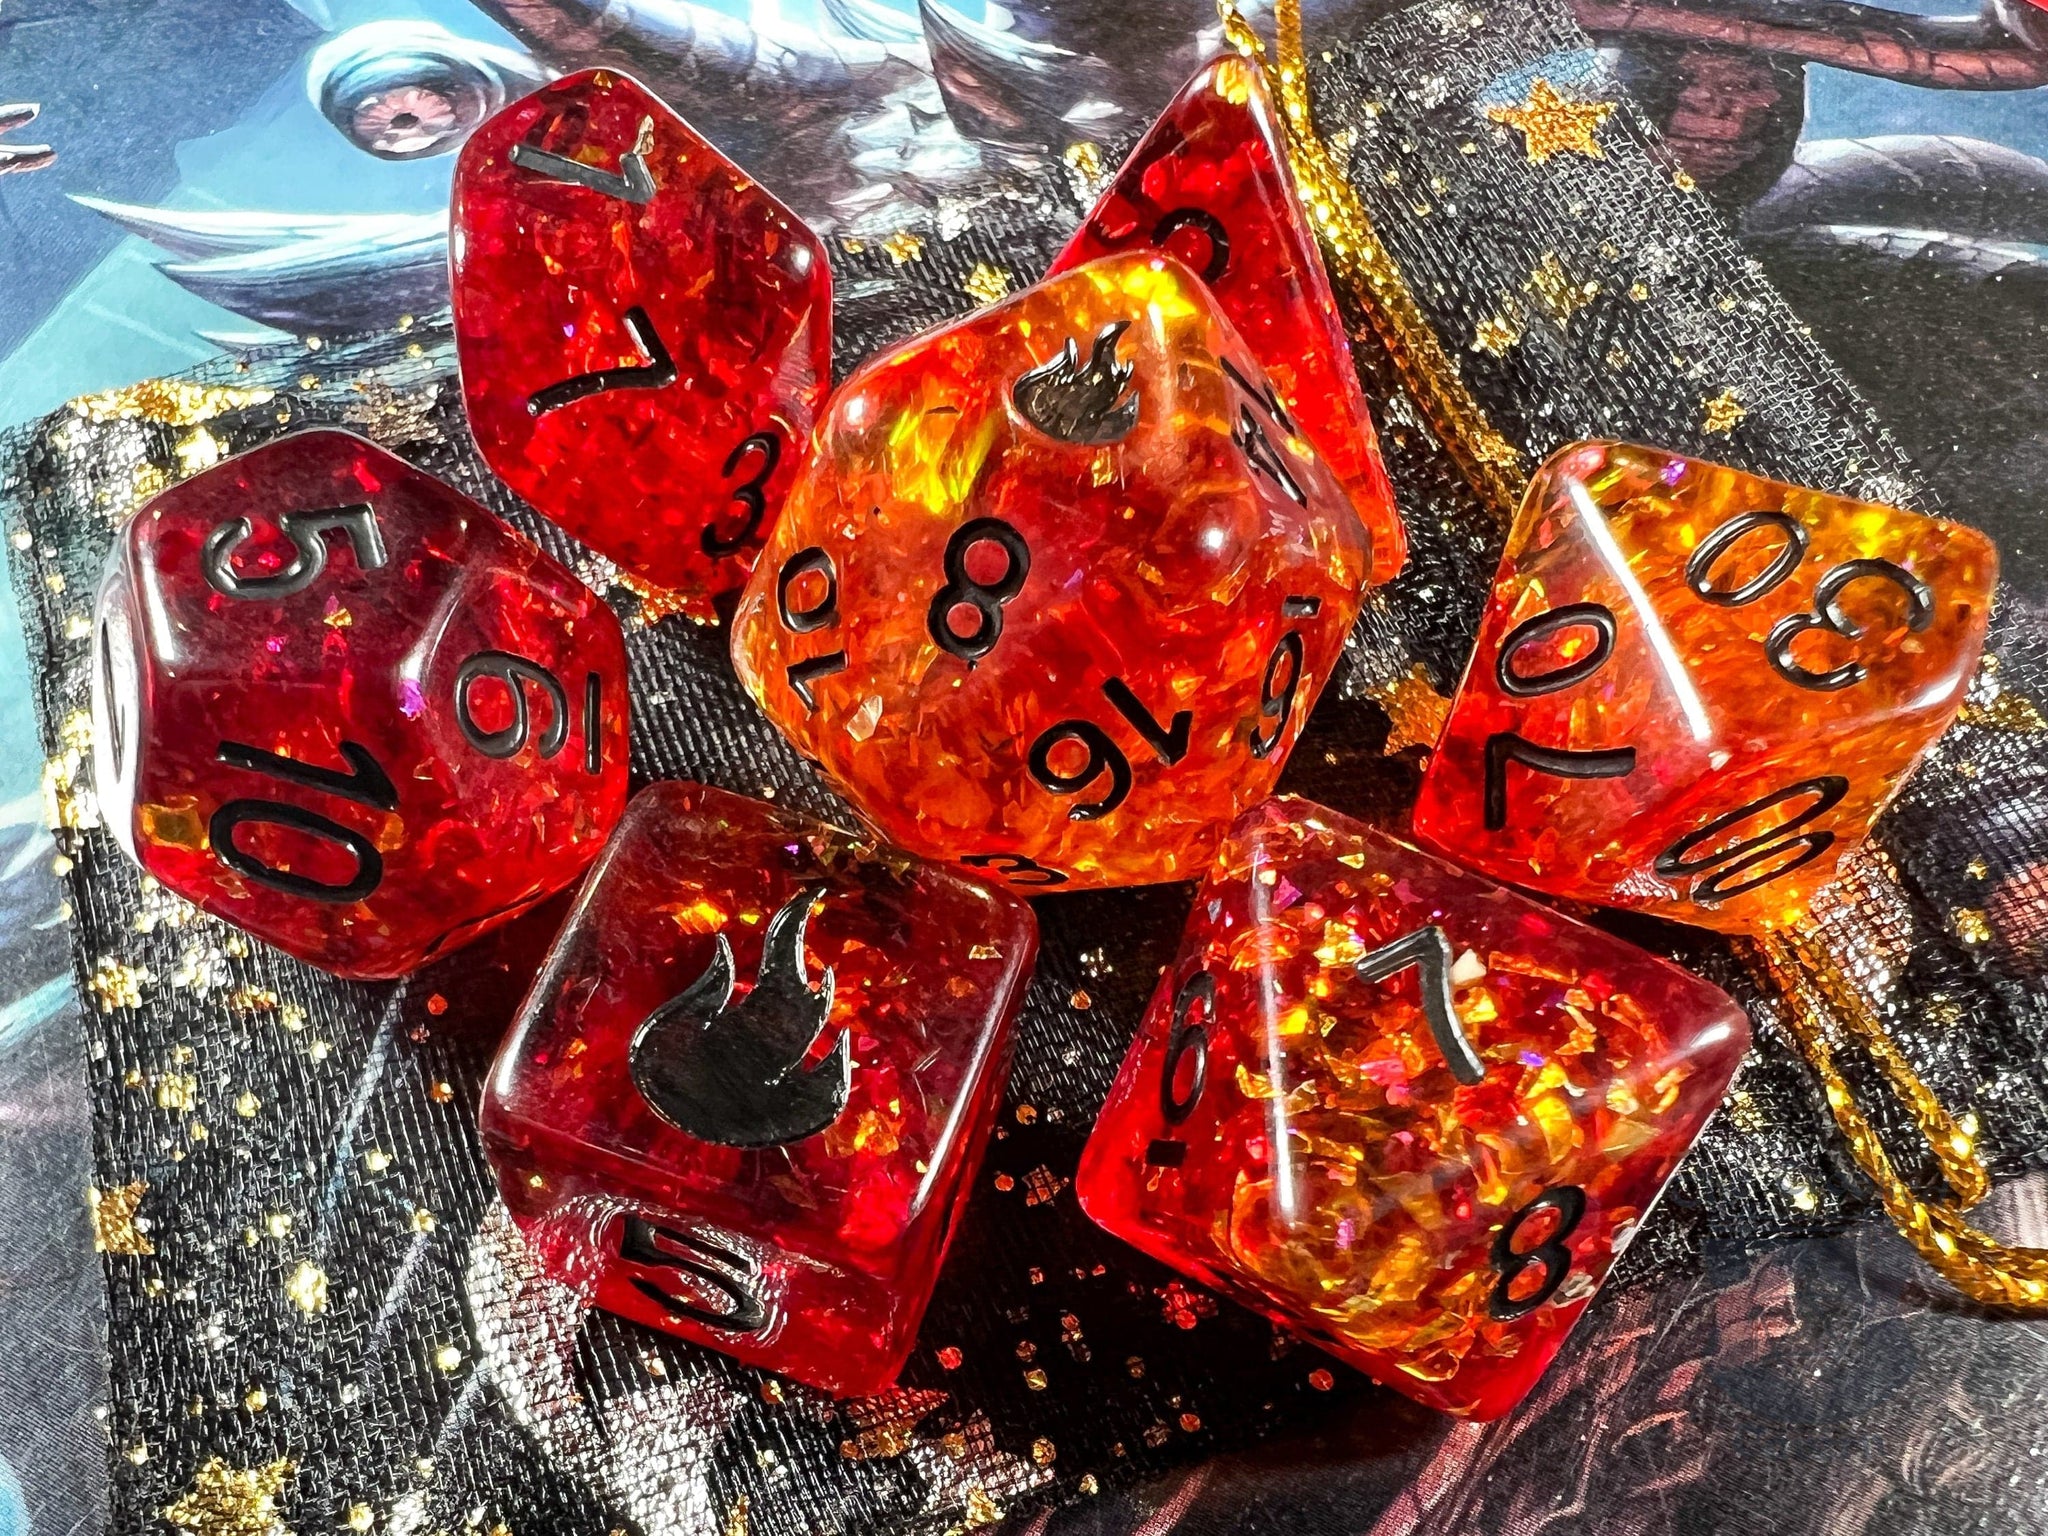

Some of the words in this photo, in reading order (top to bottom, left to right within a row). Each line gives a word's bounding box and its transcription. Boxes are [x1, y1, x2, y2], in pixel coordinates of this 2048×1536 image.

[526, 305, 679, 417] 7
[202, 502, 390, 599] 5
[700, 431, 782, 558] 3
[776, 546, 848, 713] 10
[926, 517, 1031, 660] 8
[1684, 511, 1936, 692] 30
[1027, 676, 1194, 823] 16
[1484, 602, 1637, 832] 70
[211, 739, 404, 905] 10
[1353, 925, 1486, 1086] 7
[620, 1213, 773, 1331] 5
[1490, 1184, 1586, 1323] 8
